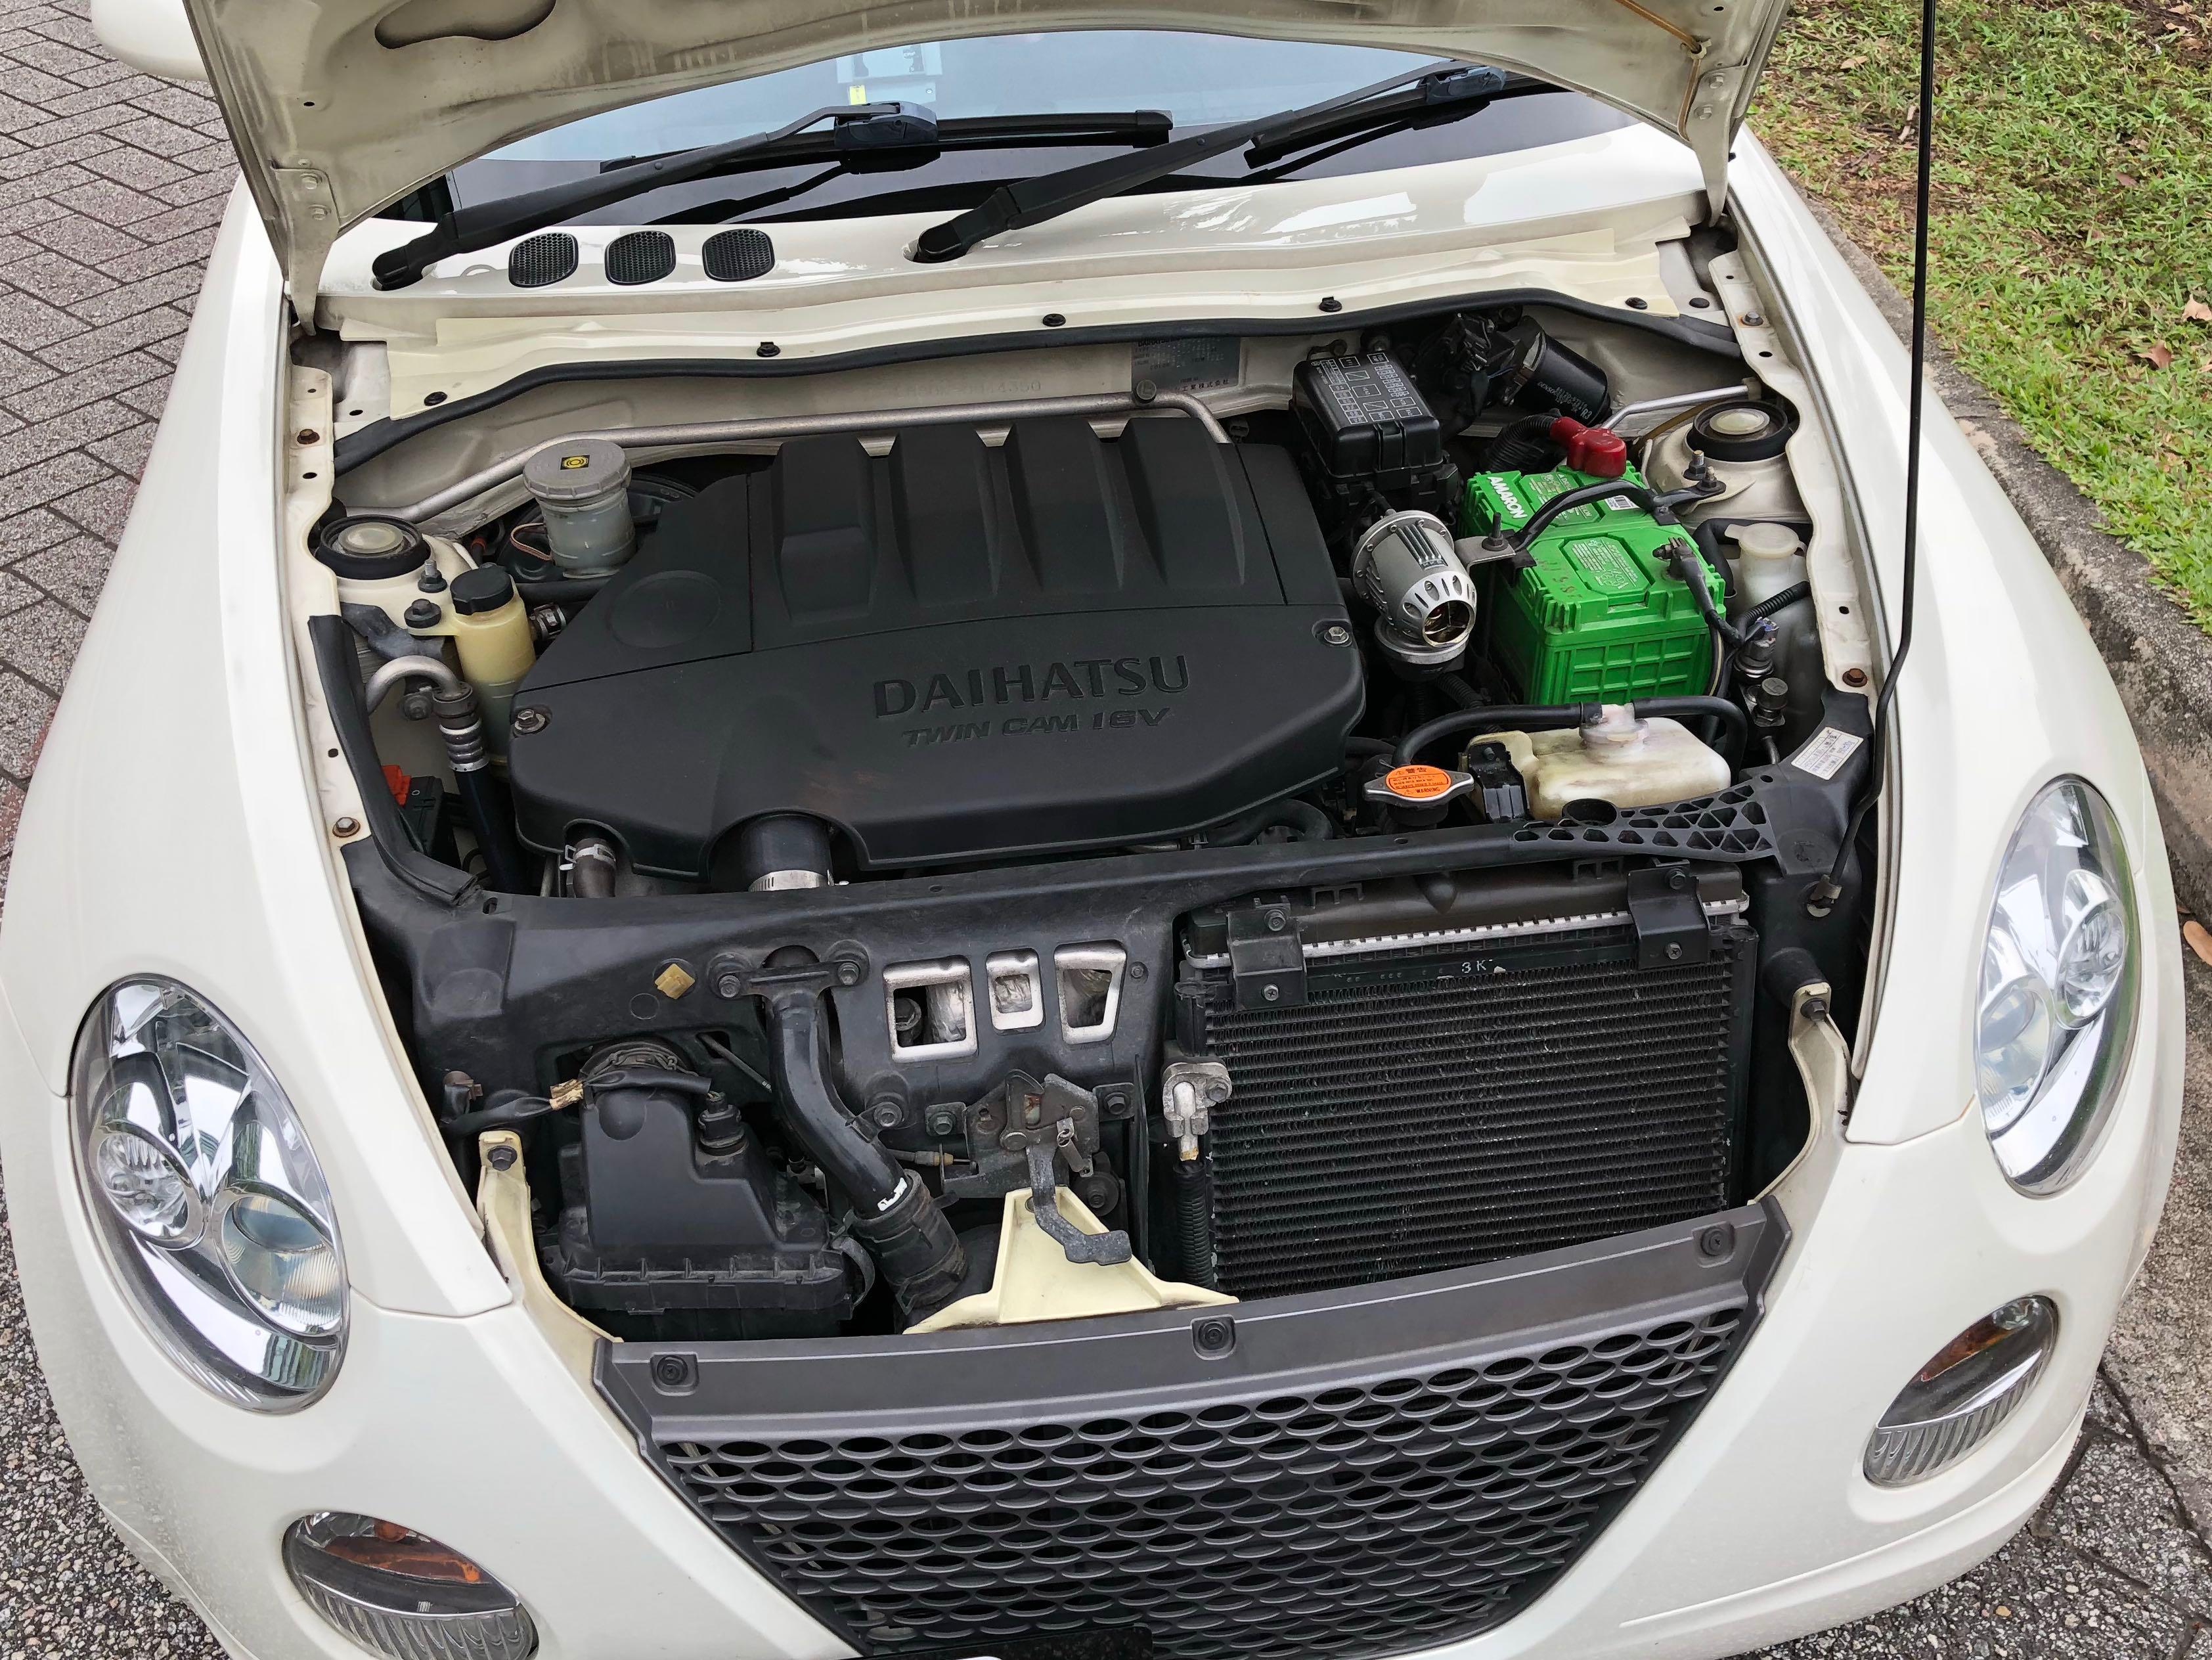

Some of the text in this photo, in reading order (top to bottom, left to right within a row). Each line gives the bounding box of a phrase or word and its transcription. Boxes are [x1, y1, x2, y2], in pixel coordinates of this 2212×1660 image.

[1487, 476, 1528, 519] AMARON
[872, 655, 1190, 718] DAIHATSU
[902, 707, 1171, 747] TWIN CAM 16V
